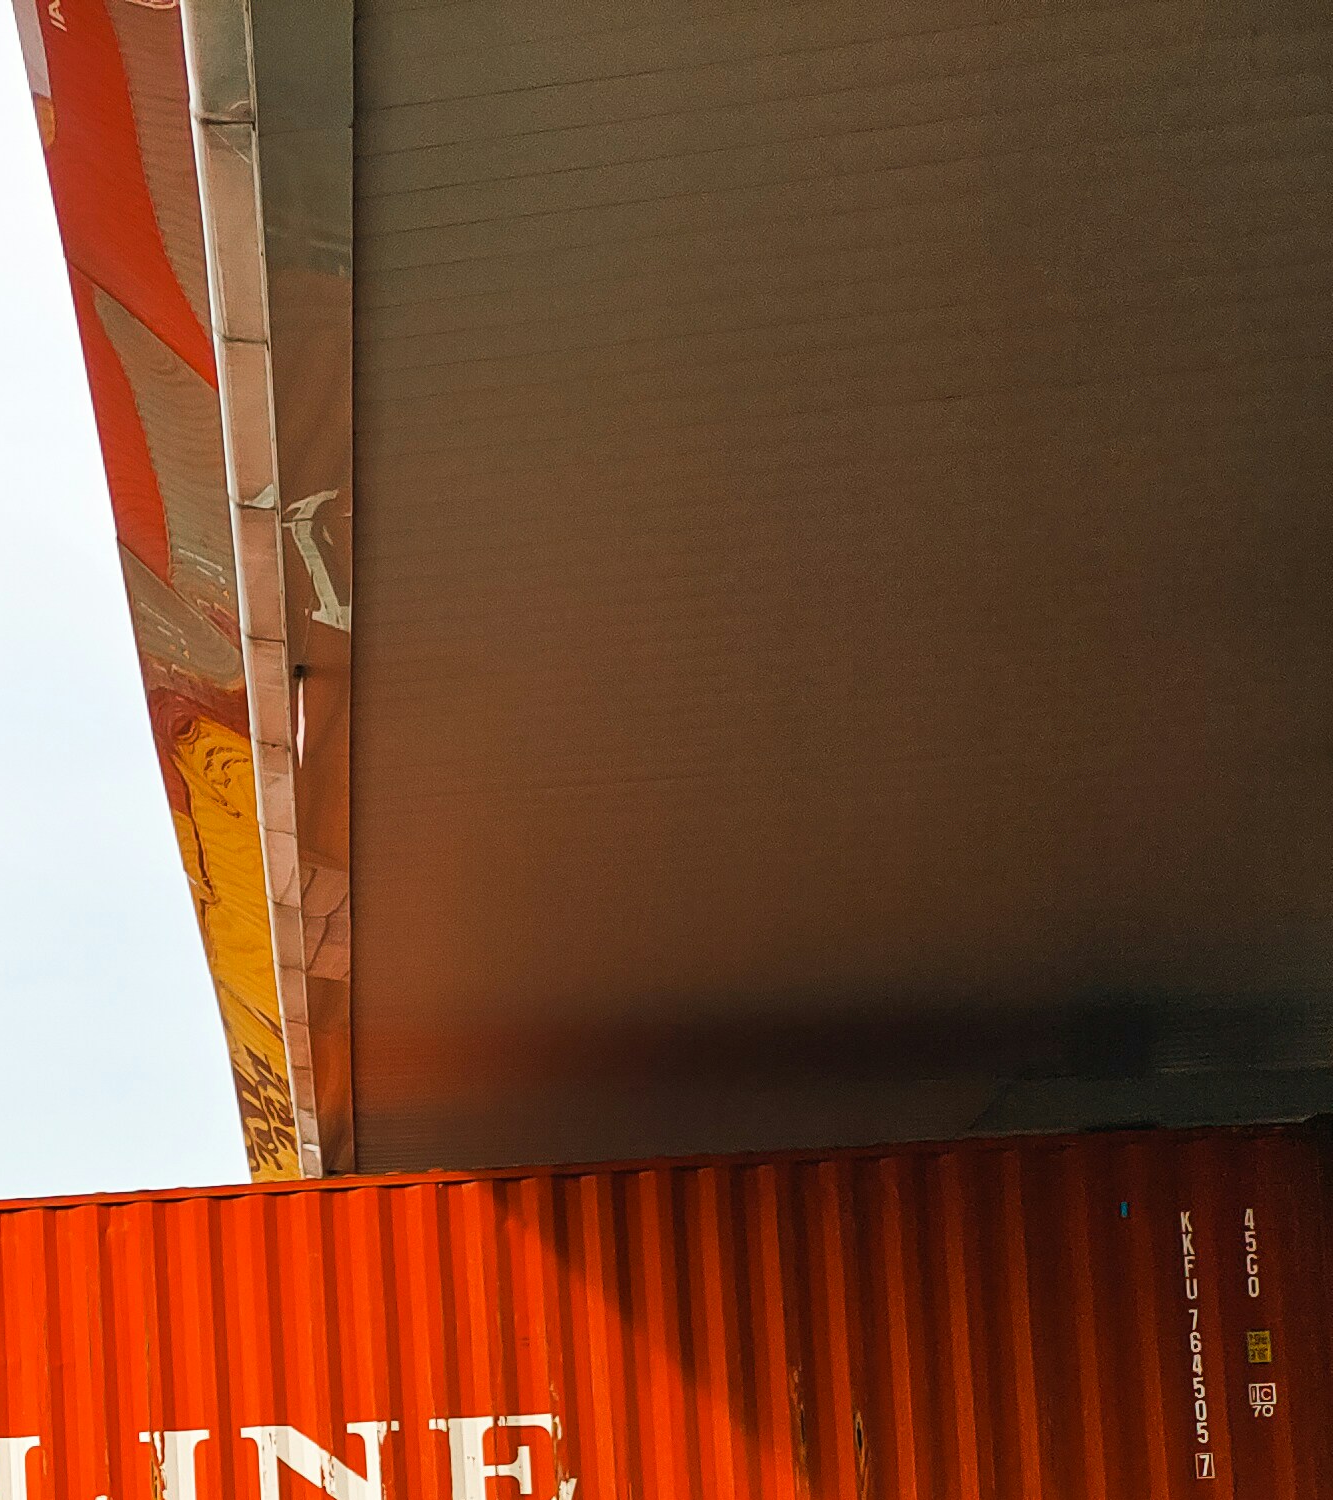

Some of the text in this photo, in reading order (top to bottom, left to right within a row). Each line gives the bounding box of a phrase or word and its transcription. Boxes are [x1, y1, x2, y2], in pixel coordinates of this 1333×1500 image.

[1244, 1208, 1260, 1298] 45G0
[1180, 1210, 1210, 1477] KKFU 764505 7
[1251, 1404, 1274, 1418] 70
